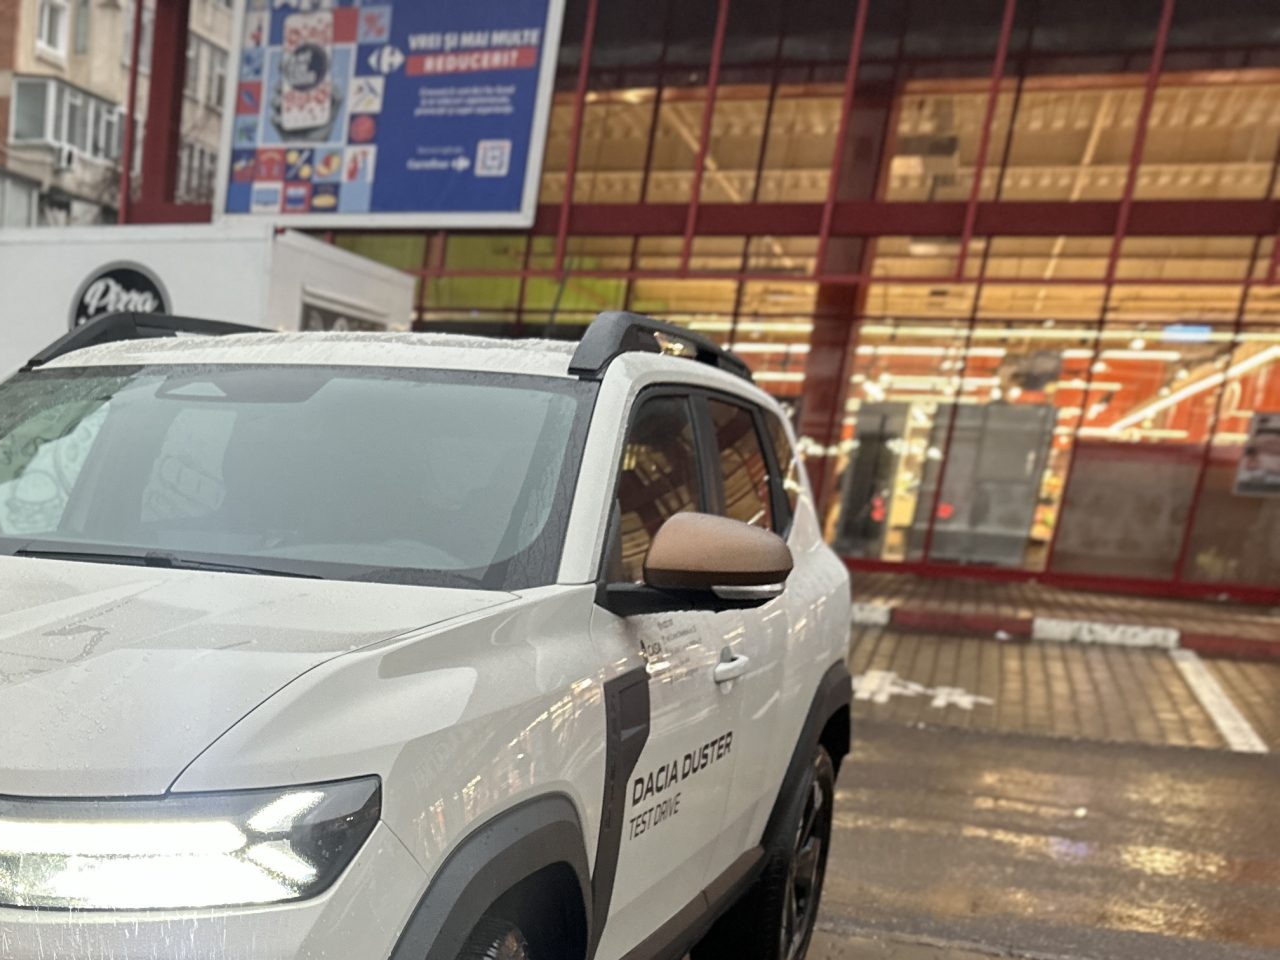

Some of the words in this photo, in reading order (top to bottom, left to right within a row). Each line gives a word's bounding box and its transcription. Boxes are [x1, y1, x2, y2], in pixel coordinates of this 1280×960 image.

[491, 28, 541, 46] MULTE
[632, 760, 678, 807] DACIA
[681, 731, 733, 780] DUSTER
[629, 808, 654, 840] TEST
[653, 792, 681, 827] DRIVE
